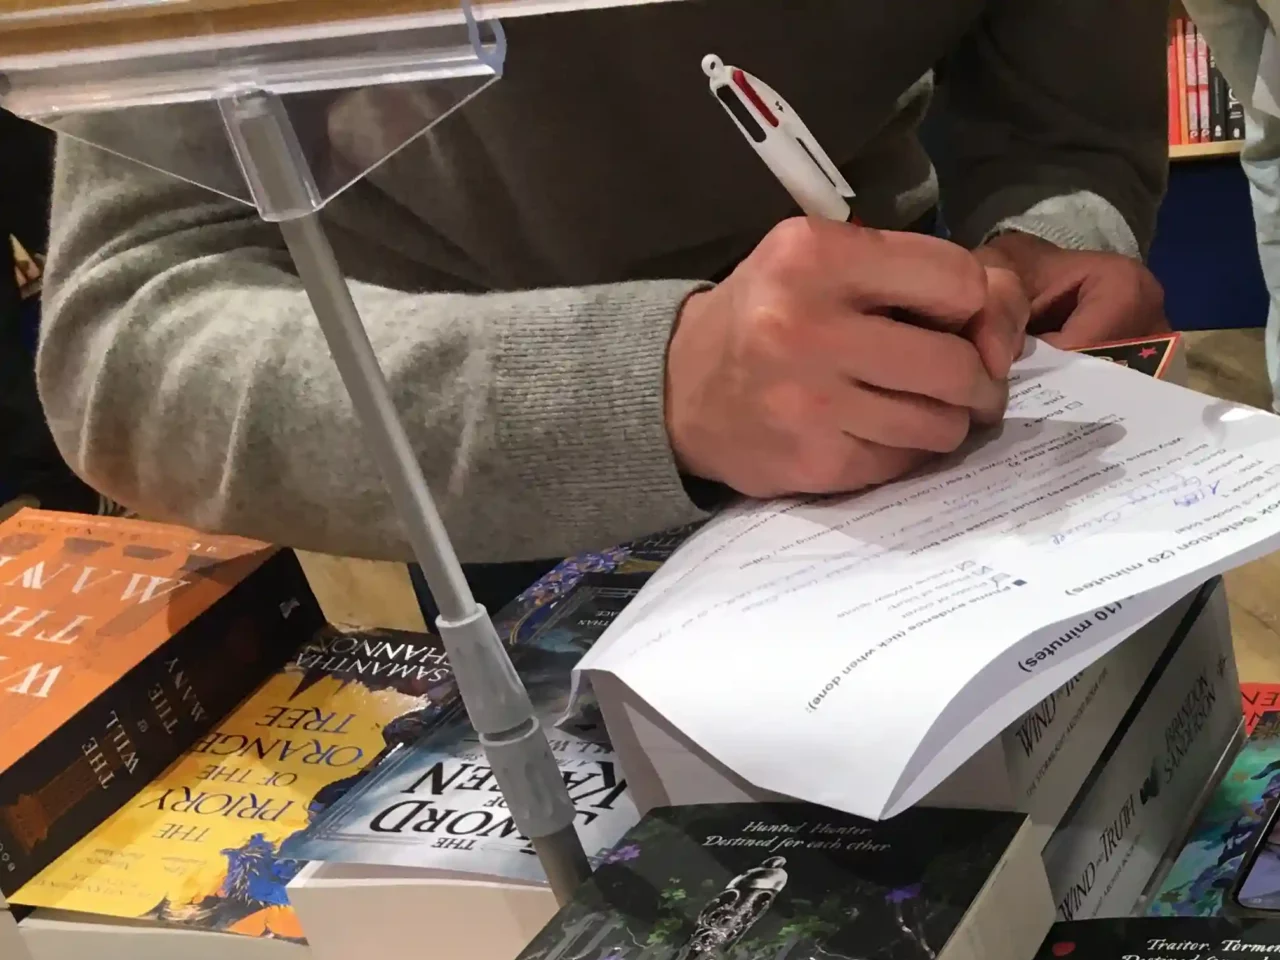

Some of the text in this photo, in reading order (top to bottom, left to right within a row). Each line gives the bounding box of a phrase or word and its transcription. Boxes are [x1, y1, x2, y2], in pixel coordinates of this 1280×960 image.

[1176, 512, 1257, 554] Selection
[1147, 547, 1175, 565] (20
[1063, 560, 1143, 597] minutes)
[0, 604, 93, 645] TH
[907, 601, 966, 632] evidence
[1016, 598, 1122, 676] (10 minutes)
[294, 652, 448, 681] SAMANTHA
[841, 647, 875, 676] when
[256, 706, 350, 735] TREE
[109, 709, 140, 775] WILL
[194, 732, 365, 768] ORANGE
[81, 736, 116, 789] THE
[195, 763, 297, 788] OF THE
[138, 782, 294, 823] PRIORY
[152, 821, 209, 843] THE
[430, 837, 478, 851] THE
[702, 835, 778, 847] Destined
[769, 838, 804, 853] for
[1056, 862, 1097, 924] WIND
[1094, 791, 1140, 862] TRUTH
